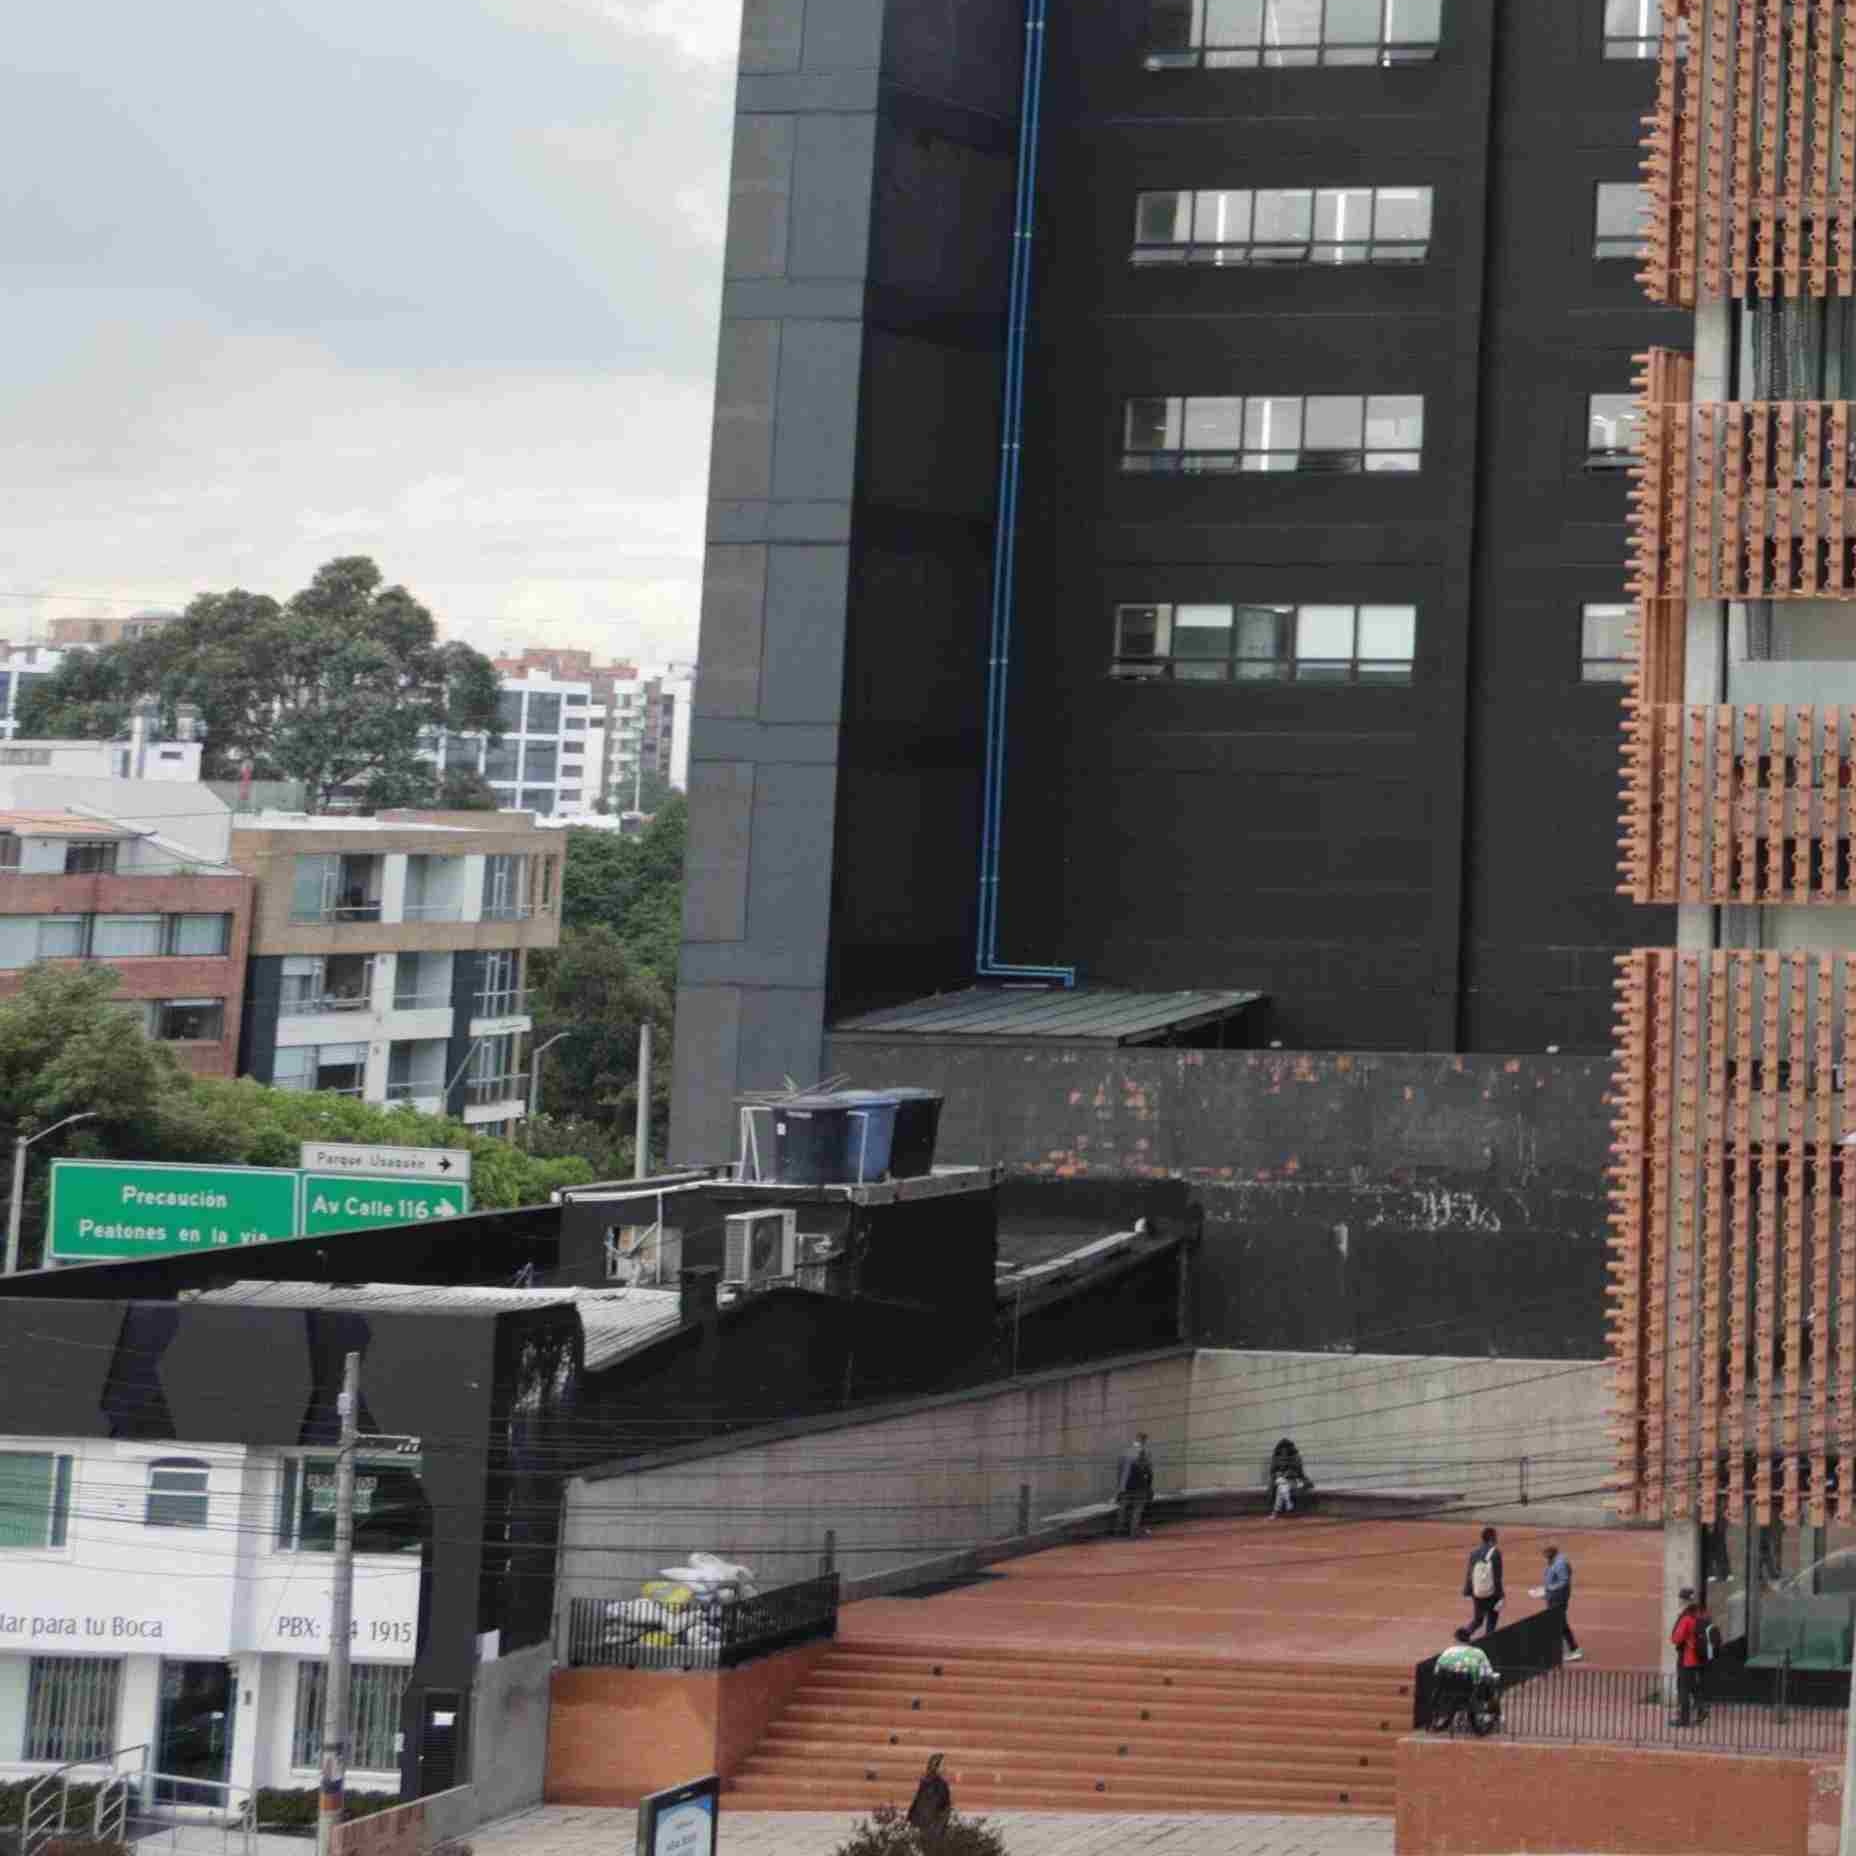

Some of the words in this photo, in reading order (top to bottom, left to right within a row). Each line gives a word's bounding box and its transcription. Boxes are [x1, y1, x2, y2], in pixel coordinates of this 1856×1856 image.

[317, 1152, 361, 1166] Parque
[122, 1185, 228, 1208] Precaución
[312, 1195, 339, 1213] Av
[345, 1197, 394, 1217] Calle
[399, 1200, 429, 1219] 116
[79, 1219, 167, 1240] Peatones
[179, 1228, 200, 1242] en
[211, 1228, 228, 1242] la
[32, 1617, 77, 1636] para
[85, 1616, 105, 1635] tu
[112, 1616, 163, 1637] Boca
[278, 1616, 320, 1638] PBX:
[370, 1620, 413, 1642] 1915
